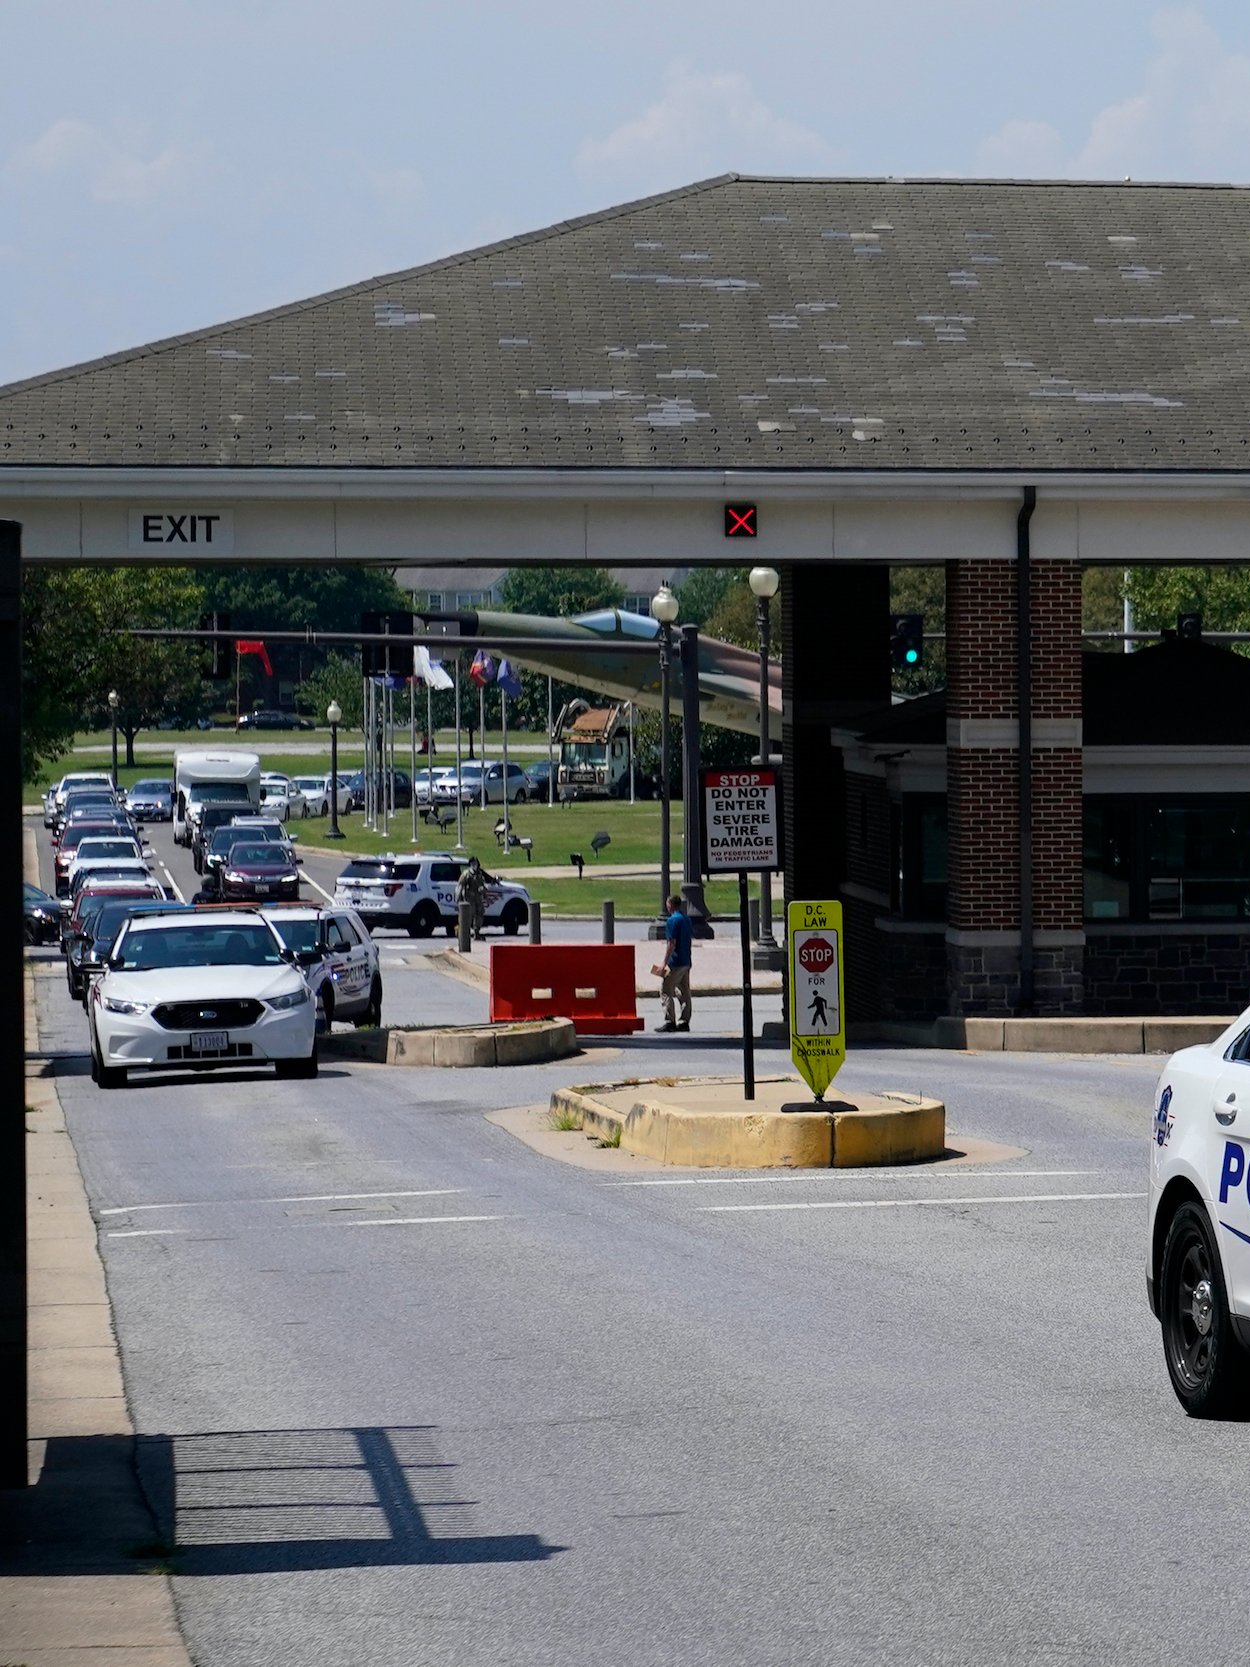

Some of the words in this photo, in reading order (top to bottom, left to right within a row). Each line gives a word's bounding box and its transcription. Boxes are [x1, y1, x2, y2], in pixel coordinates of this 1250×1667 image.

[143, 515, 220, 542] EXIT
[720, 774, 760, 786] STOP
[711, 788, 732, 799] DO
[738, 787, 769, 798] NOT
[715, 800, 766, 811] ENTER
[713, 814, 770, 825] SEVERE
[725, 825, 759, 836] TIRE
[710, 836, 774, 848] DAMAGE
[805, 905, 826, 916] D.C.
[804, 917, 827, 928] LAW
[801, 949, 832, 962] STOP
[345, 963, 371, 982] POLICE
[808, 977, 826, 985] FOR
[806, 1038, 831, 1046] WITHIN
[797, 1048, 840, 1057] CROSSWALK
